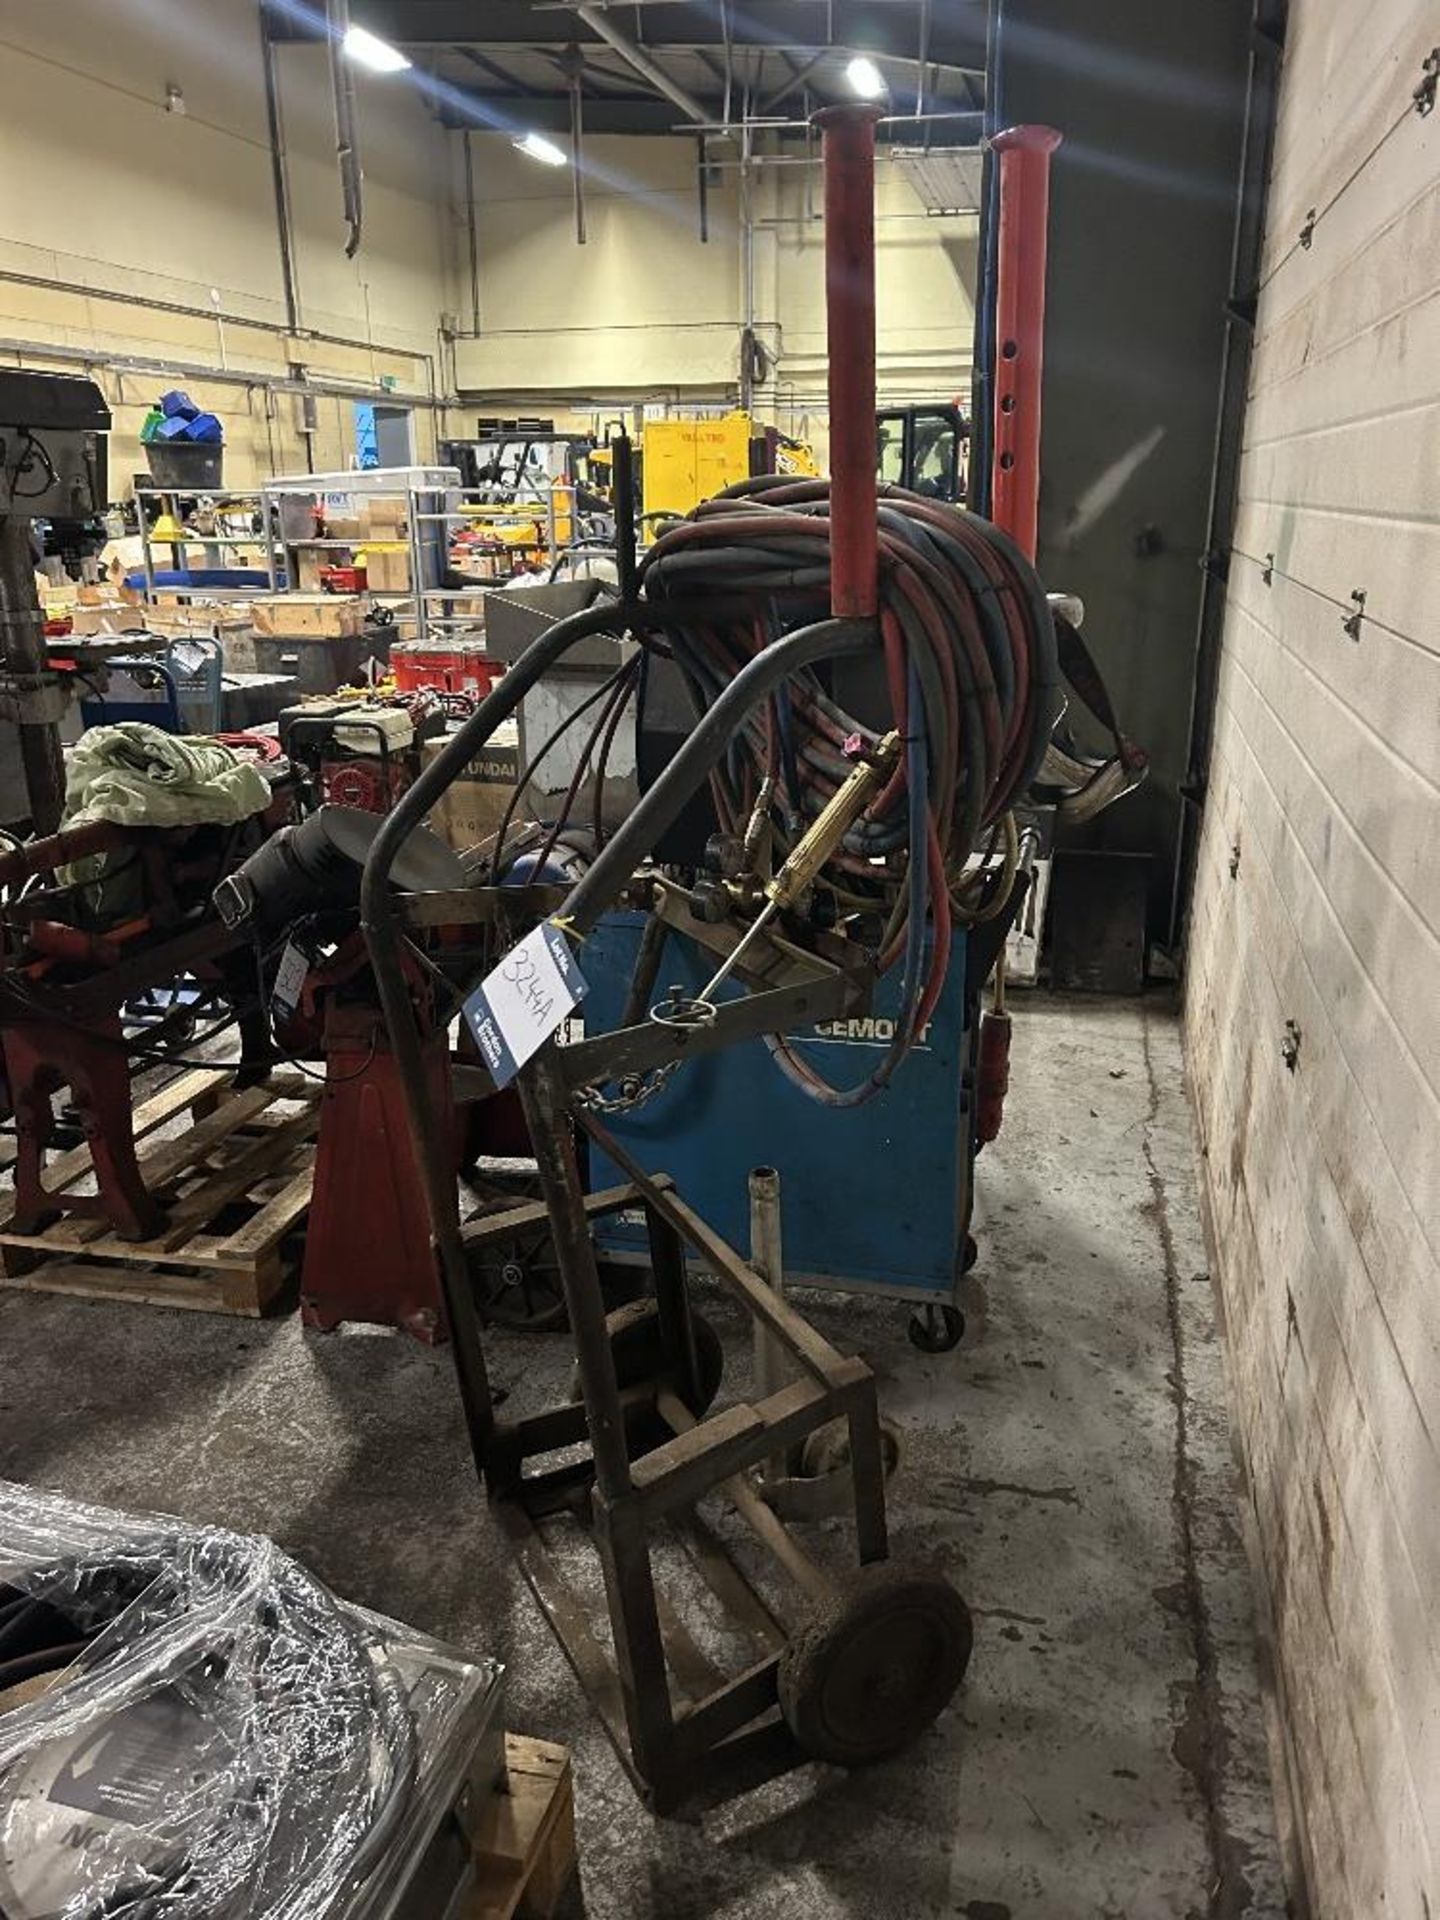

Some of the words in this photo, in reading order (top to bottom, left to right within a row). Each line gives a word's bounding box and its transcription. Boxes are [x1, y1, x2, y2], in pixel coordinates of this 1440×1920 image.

[462, 761, 515, 777] UNDAI
[477, 1024, 500, 1069] Brothers
[483, 1017, 502, 1056] Gordon
[814, 1018, 932, 1043] CEMOT
